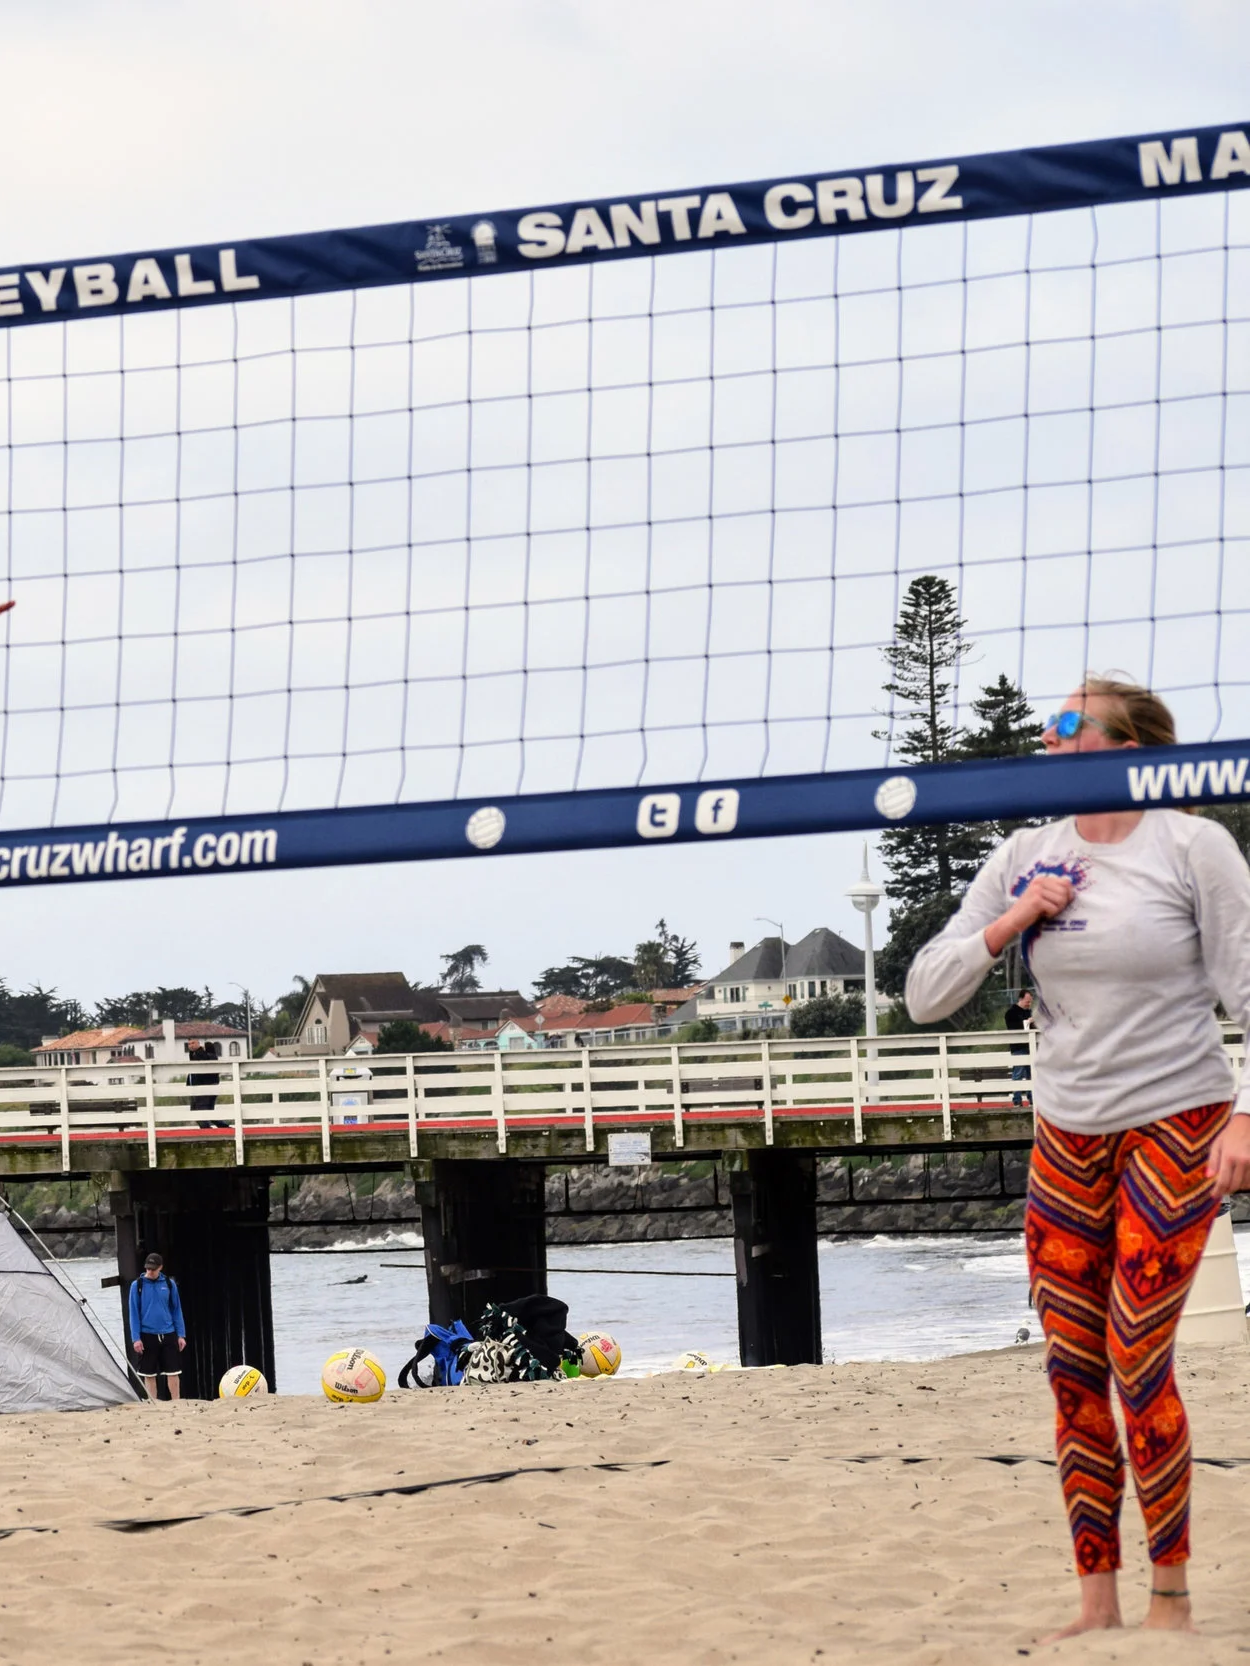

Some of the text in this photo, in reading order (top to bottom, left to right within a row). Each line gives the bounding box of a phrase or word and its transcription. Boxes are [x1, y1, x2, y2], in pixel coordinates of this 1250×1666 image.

[517, 165, 963, 259] SANTA CRUZ
[335, 1381, 359, 1394] Wilson
